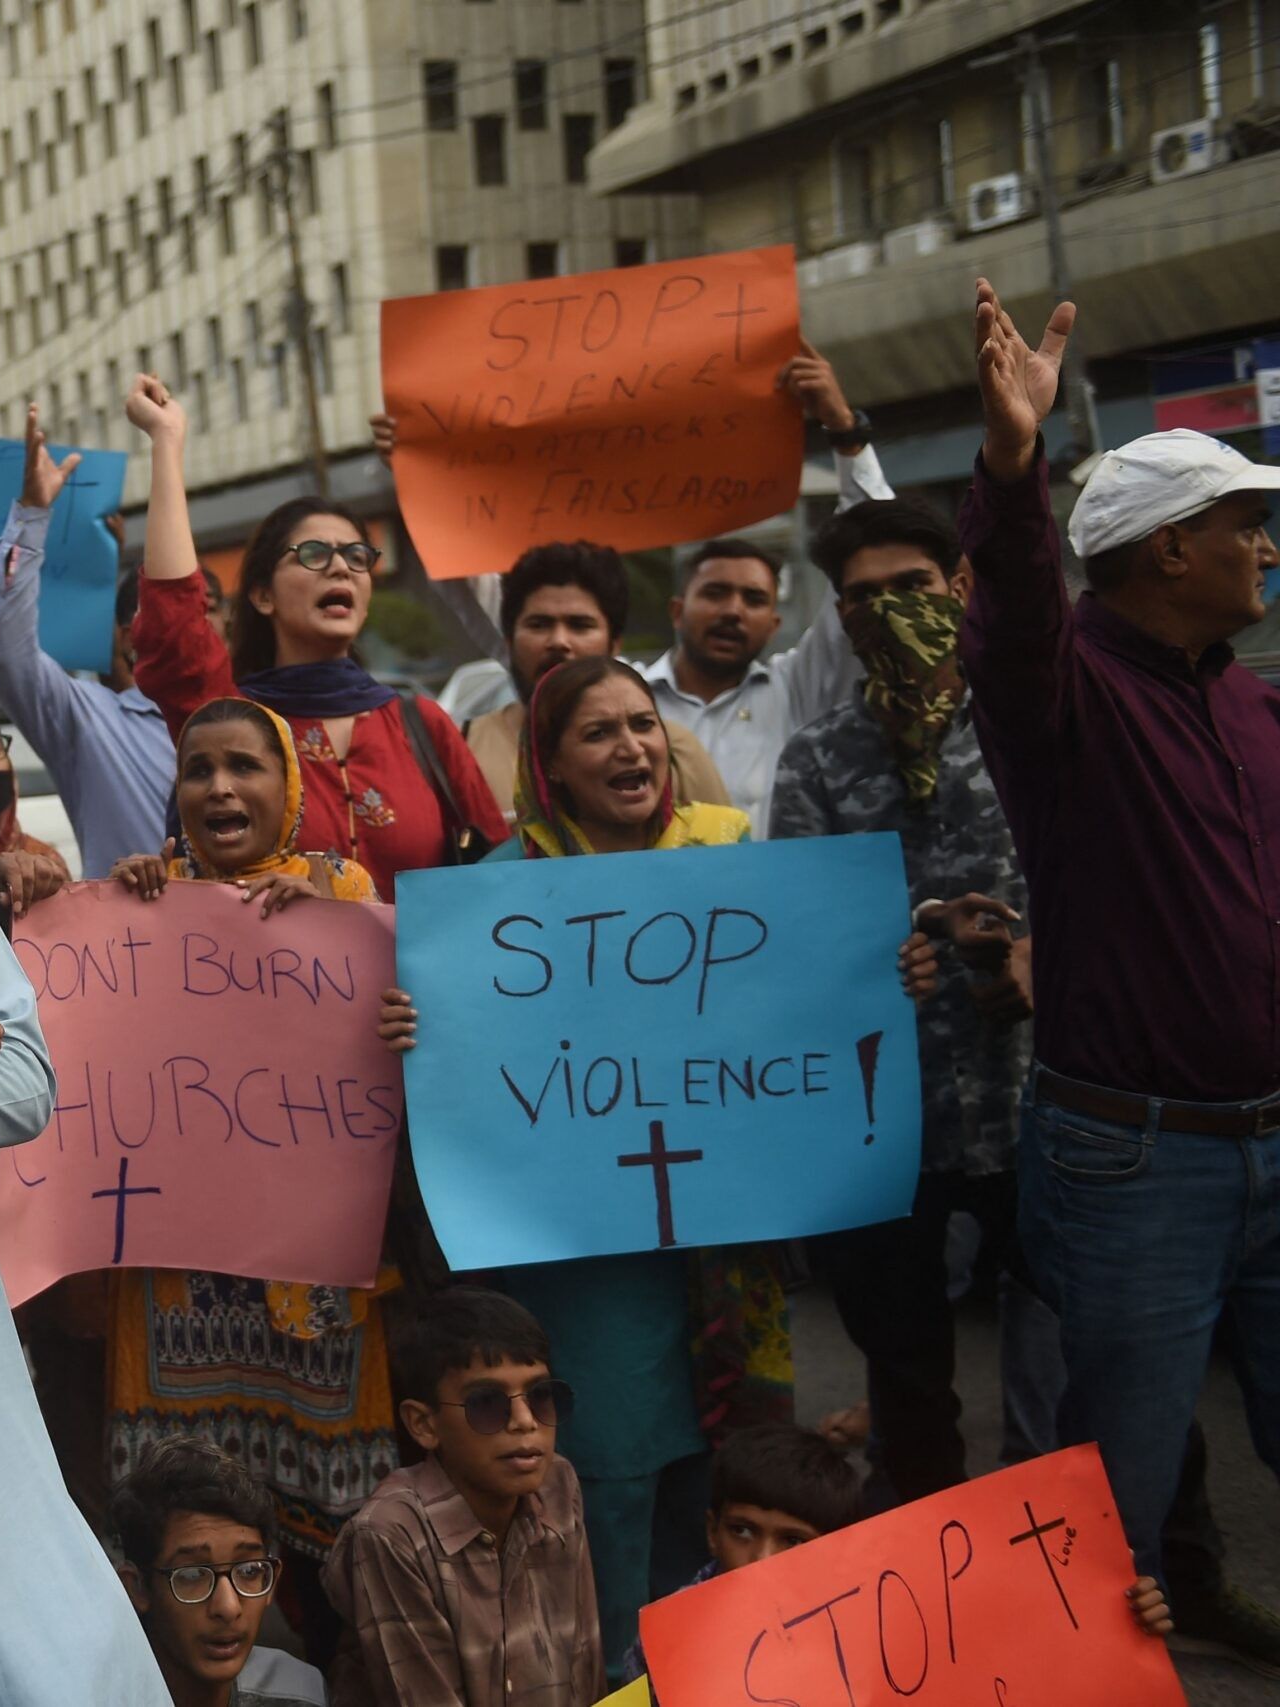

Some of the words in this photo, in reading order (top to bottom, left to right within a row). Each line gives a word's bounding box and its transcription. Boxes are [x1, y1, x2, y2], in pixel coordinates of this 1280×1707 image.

[486, 275, 705, 372] STOP
[421, 353, 723, 435] VIOLENCE
[535, 411, 744, 462] ATTACKS
[465, 492, 499, 532] IN
[181, 933, 356, 1005] BURN
[491, 907, 768, 1015] STOP
